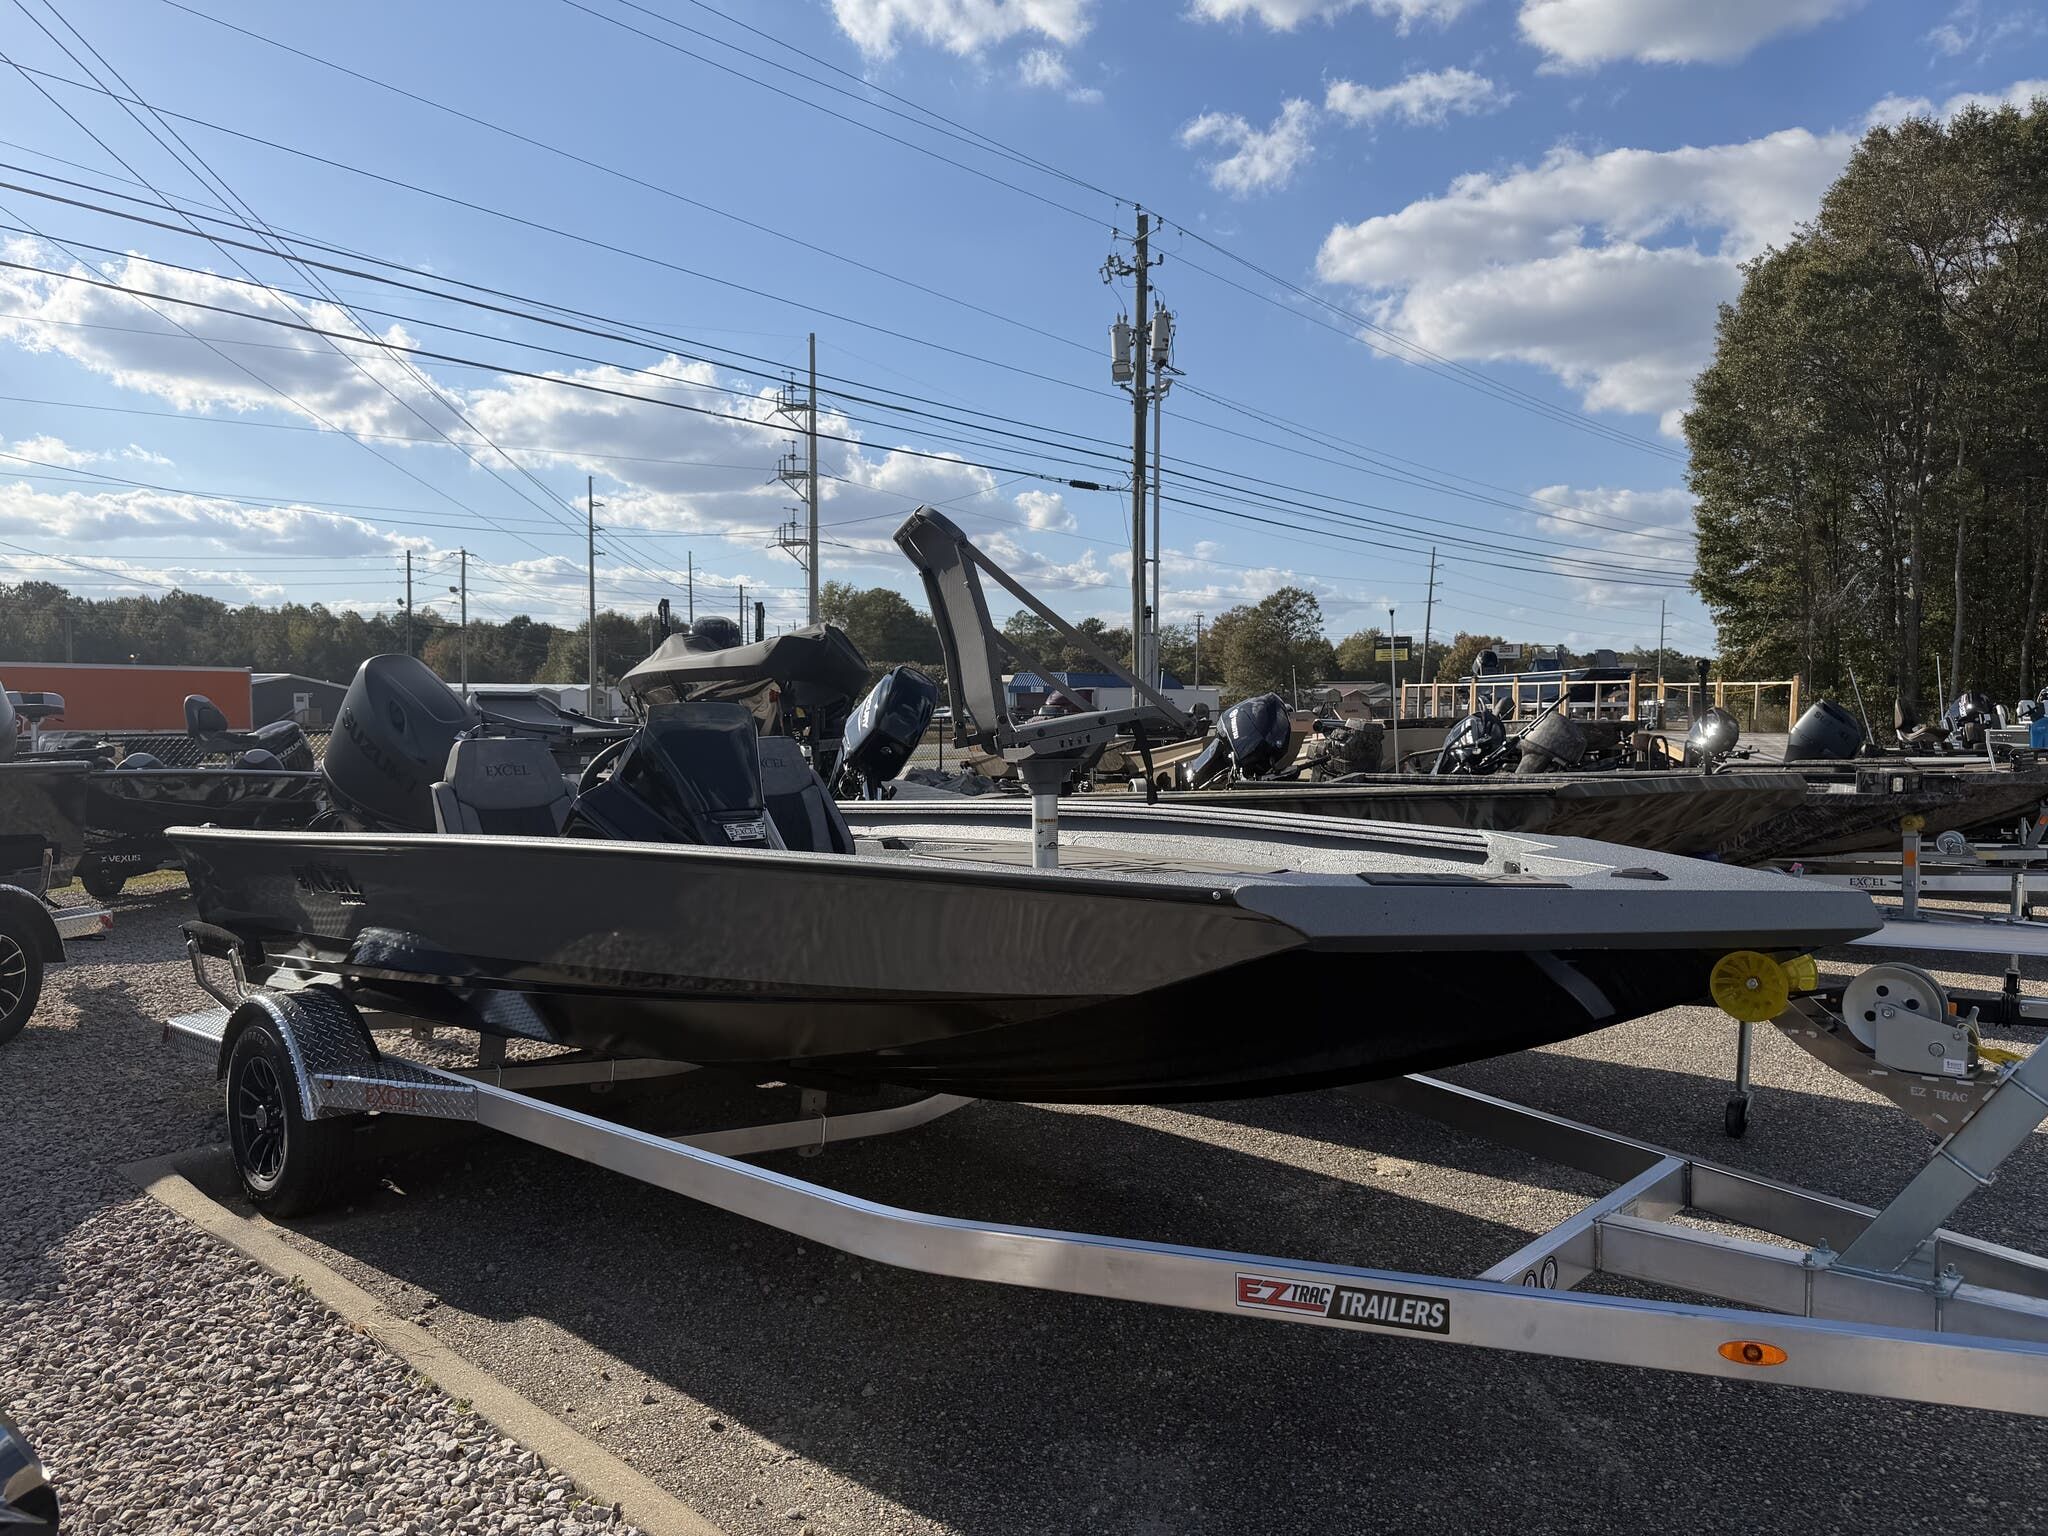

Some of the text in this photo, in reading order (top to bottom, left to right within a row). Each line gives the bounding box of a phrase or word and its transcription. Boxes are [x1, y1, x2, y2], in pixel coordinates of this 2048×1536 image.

[486, 762, 531, 777] EXCEL
[759, 758, 787, 769] XCEL
[108, 854, 141, 863] VEXUS
[1849, 876, 1887, 887] EXCEL
[1910, 1086, 1968, 1103] EZ TRAC
[1339, 1290, 1446, 1328] TRAILERS
